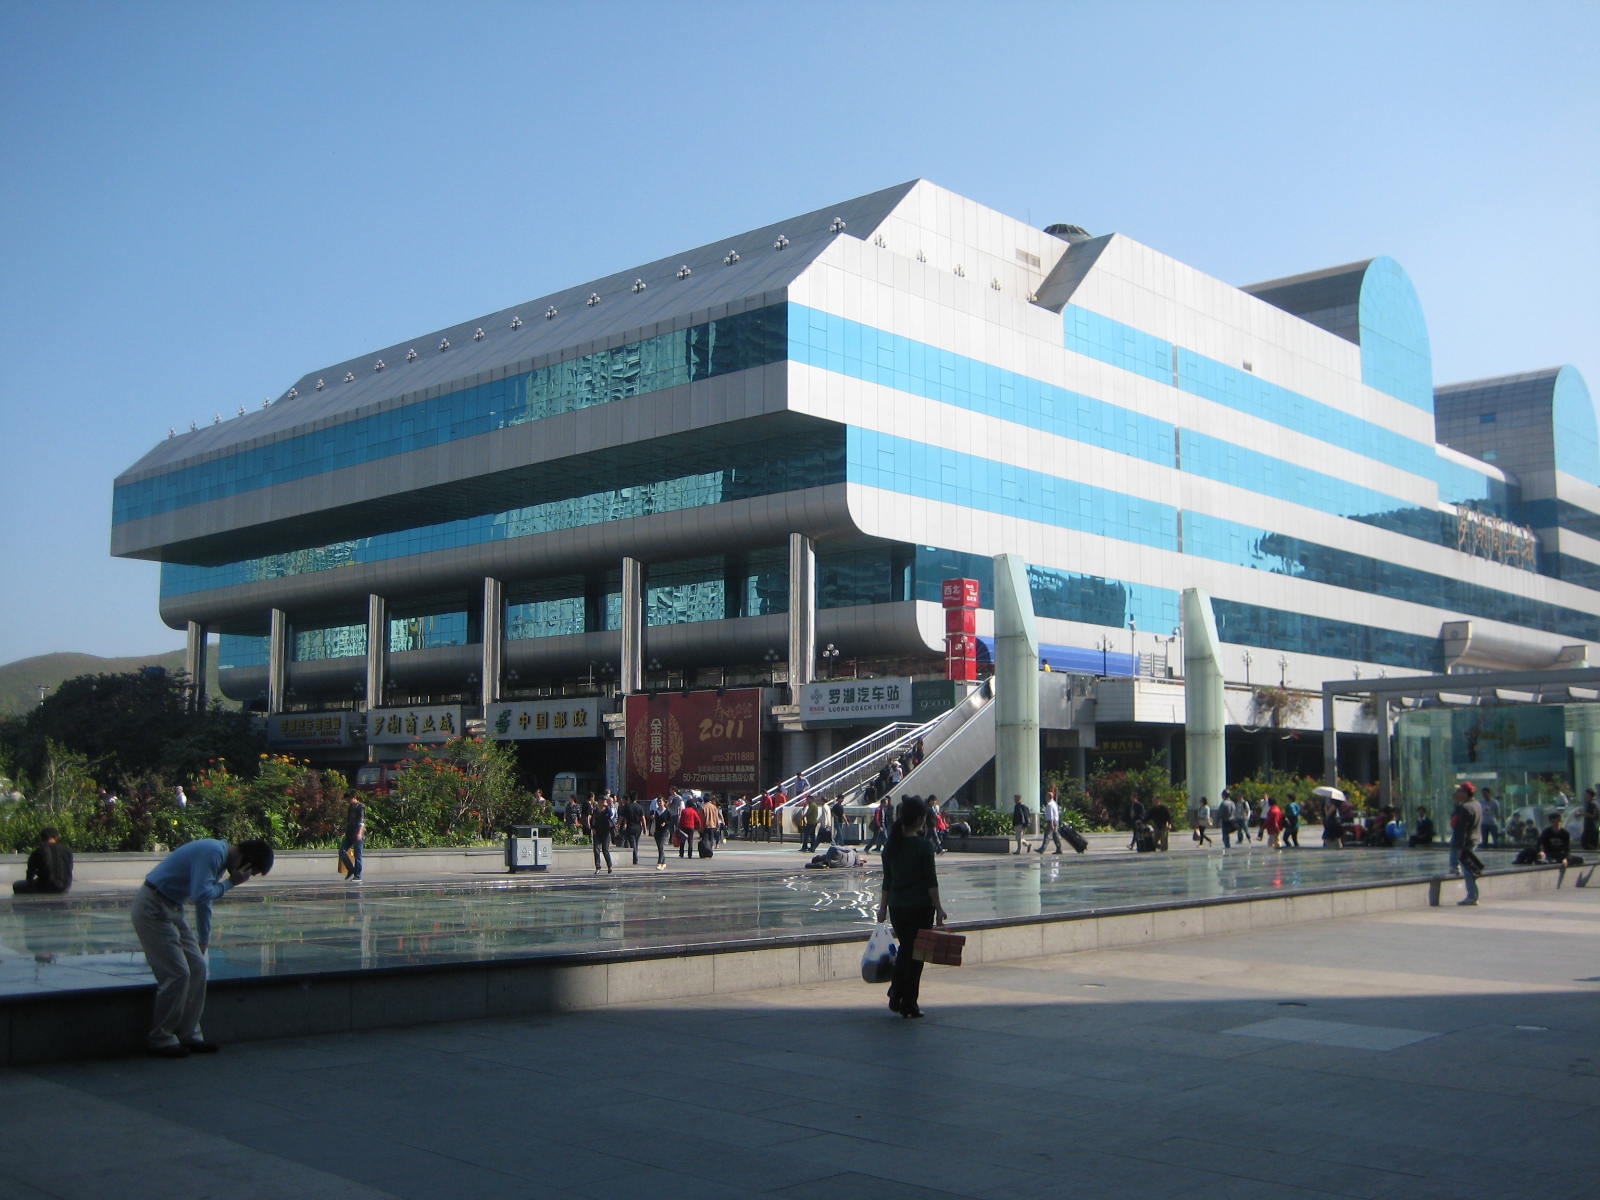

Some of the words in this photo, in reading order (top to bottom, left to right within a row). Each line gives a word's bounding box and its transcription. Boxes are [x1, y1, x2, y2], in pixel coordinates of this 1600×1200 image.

[828, 685, 899, 705] 罗湖汽车站
[873, 703, 900, 711] STATION
[374, 712, 455, 736] 罗湖商业城
[519, 709, 587, 730] 中国邮政
[699, 718, 744, 742] 2011
